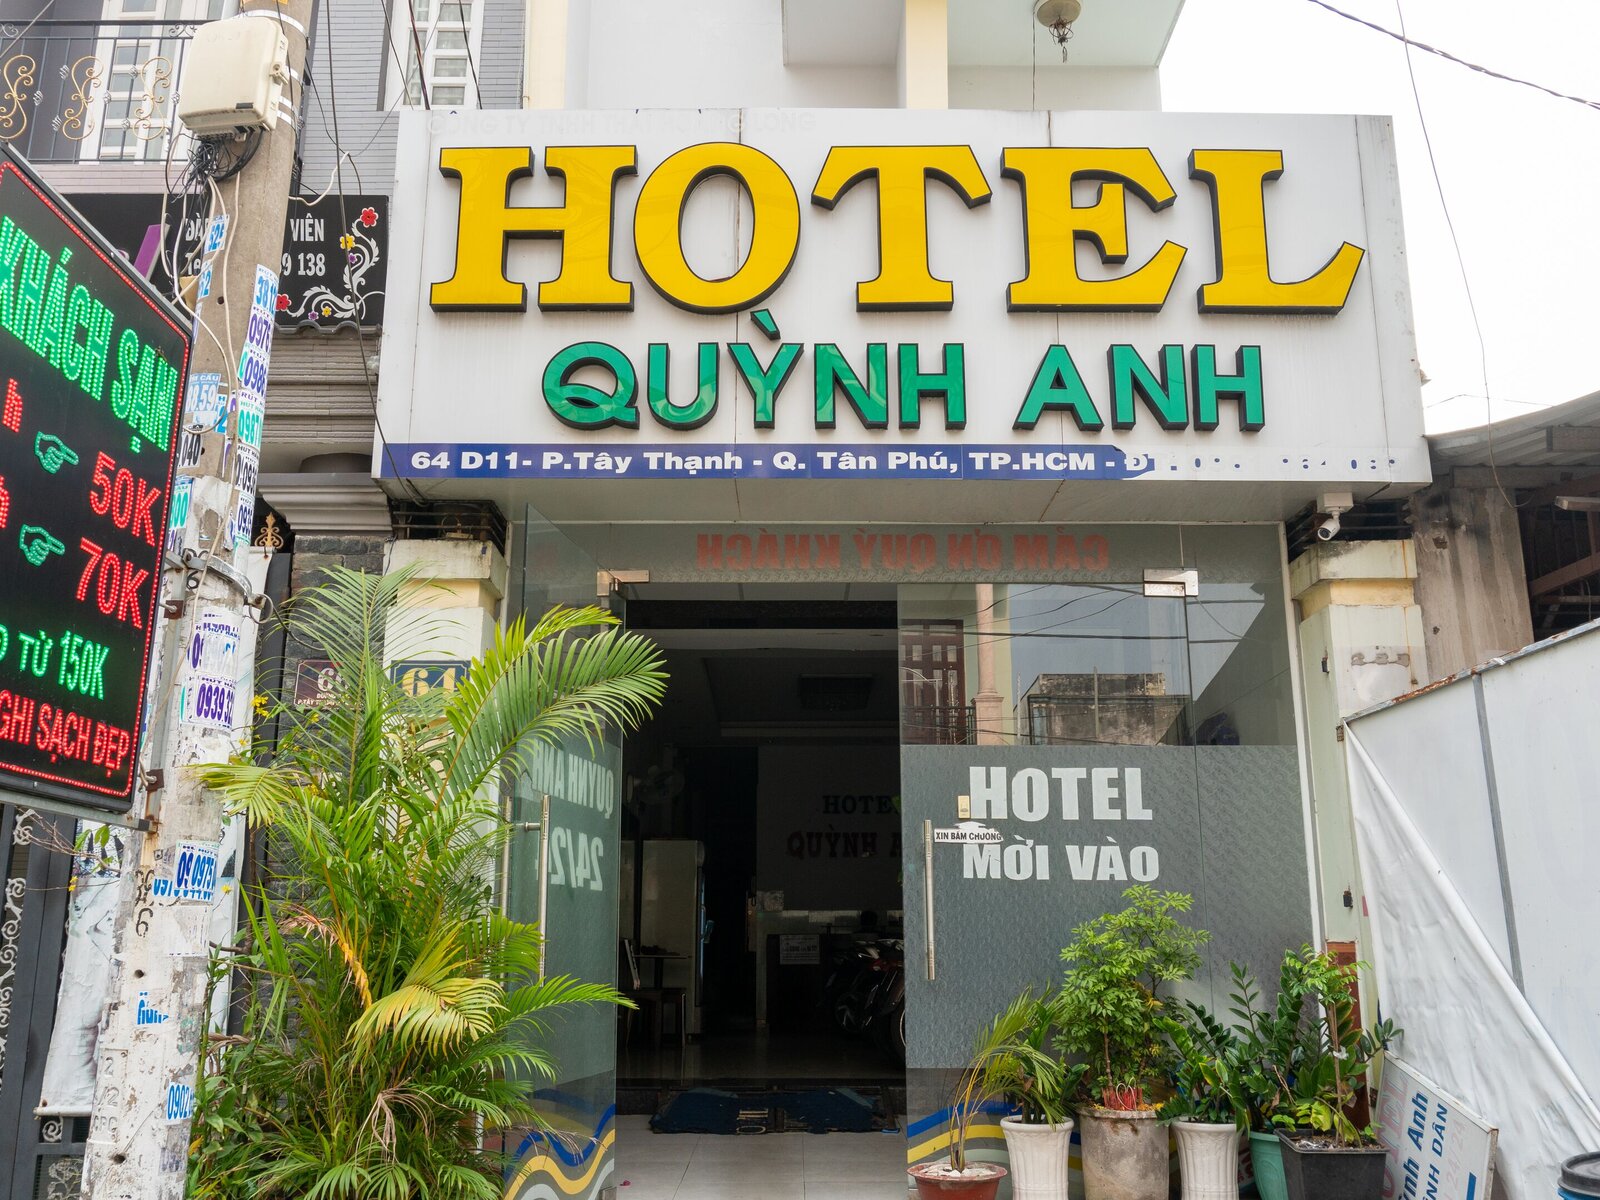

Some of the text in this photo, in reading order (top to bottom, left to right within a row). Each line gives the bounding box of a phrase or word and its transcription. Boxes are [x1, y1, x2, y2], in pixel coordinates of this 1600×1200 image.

[290, 213, 325, 242] VIÊN
[430, 141, 1365, 315] HOTEL
[297, 253, 326, 276] 138
[0, 215, 179, 454] KHÁCH SẠN
[542, 308, 1266, 432] QUỲNH ANH
[411, 452, 450, 470] 64
[542, 452, 632, 474] P.Tây
[643, 452, 743, 475] Thạnh
[772, 452, 806, 471] Q.
[816, 452, 877, 470] Tân
[888, 452, 958, 474] Phú,
[968, 452, 1096, 471] TP.HCM
[89, 450, 161, 547] 50K
[76, 536, 149, 630] 70K
[58, 629, 110, 701] 150K
[36, 702, 92, 764] SẠCH
[969, 766, 1153, 822] HOTEL
[935, 831, 949, 841] XIN
[962, 834, 1159, 882] MỜI VÀO
[1407, 1091, 1429, 1152] Anh
[1431, 1103, 1449, 1158] DÂN
